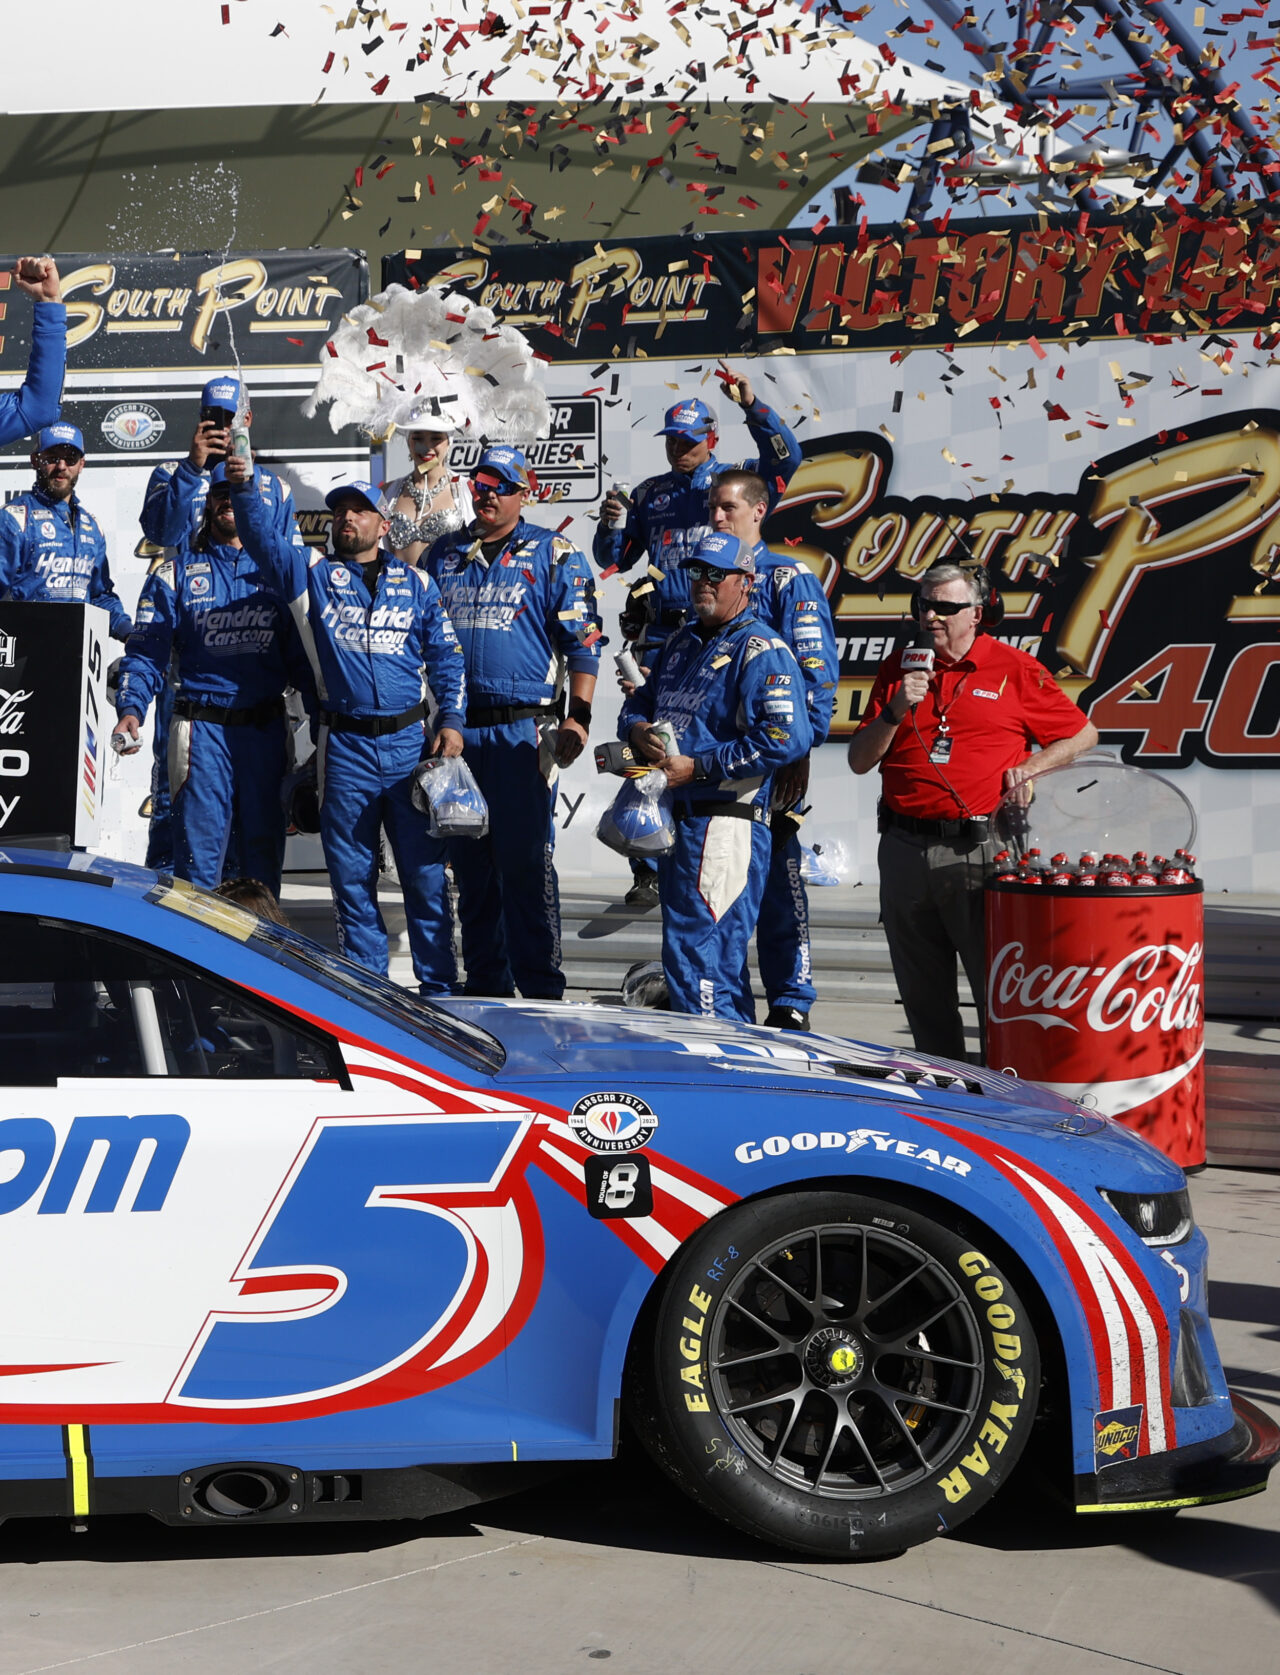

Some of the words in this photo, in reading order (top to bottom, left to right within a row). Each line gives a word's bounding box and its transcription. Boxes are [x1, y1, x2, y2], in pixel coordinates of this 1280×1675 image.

[190, 258, 343, 354] POINT
[320, 599, 416, 630] Hendrick
[204, 629, 274, 647] Cars.com
[903, 653, 928, 663] PRN
[988, 941, 1203, 1033] Coca-Cola
[578, 1094, 616, 1112] NASCAR
[619, 1094, 645, 1112] 75TH
[642, 1117, 656, 1125] 2023
[579, 1128, 650, 1150] ANNIVERSARY
[602, 1170, 610, 1179] OF
[604, 1162, 640, 1210] 8
[597, 1179, 608, 1204] ROUND
[166, 1112, 539, 1410] 5
[678, 1283, 713, 1413] EAGLE
[1095, 1424, 1139, 1450] SUNOCO
